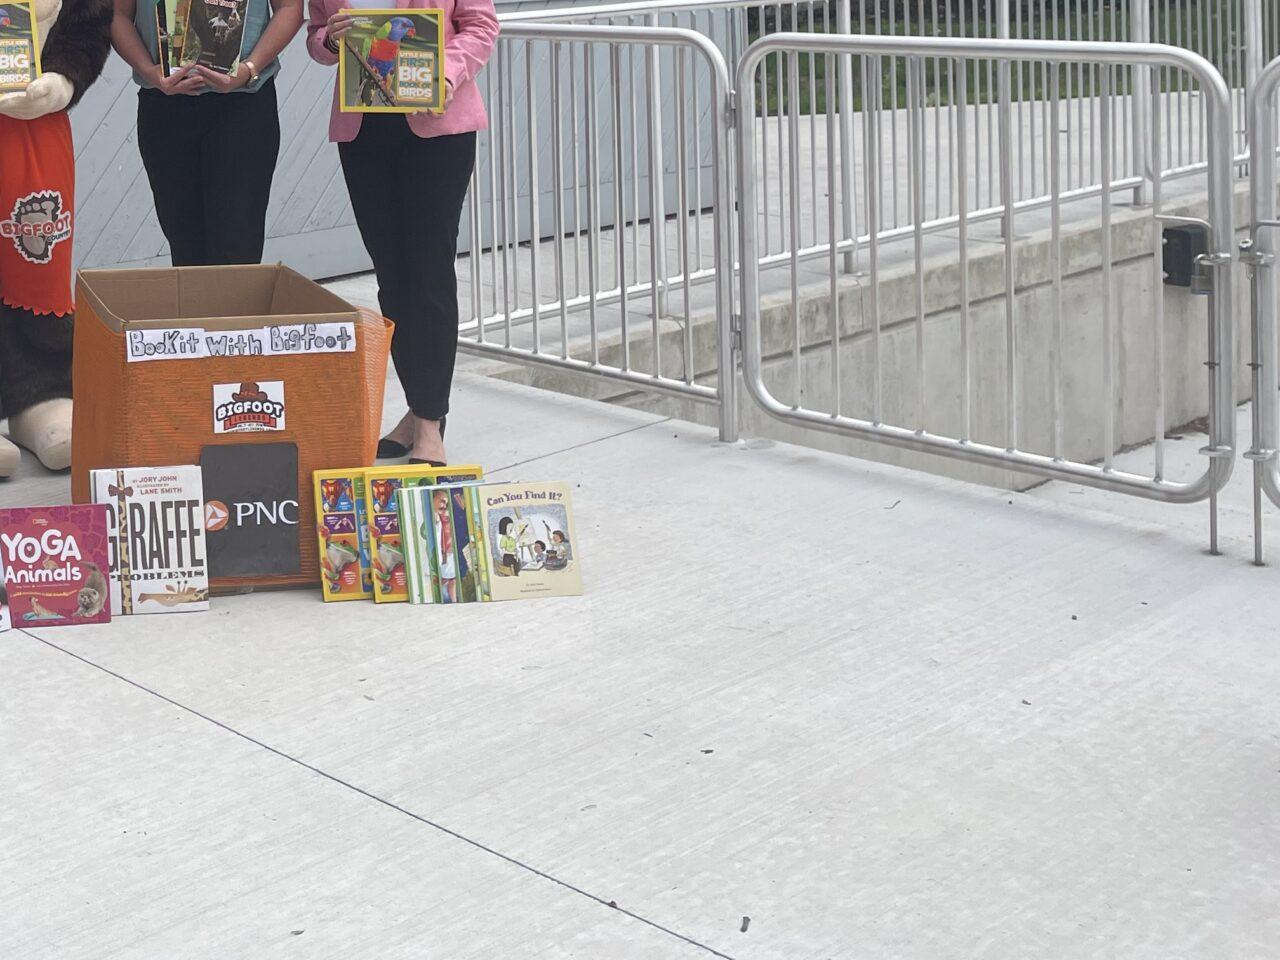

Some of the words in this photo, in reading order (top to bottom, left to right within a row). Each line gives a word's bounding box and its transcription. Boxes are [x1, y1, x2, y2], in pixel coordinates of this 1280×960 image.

[0, 74, 30, 83] BIRDS
[399, 66, 432, 81] BIG
[399, 87, 432, 97] BIRDS
[1, 215, 69, 237] BIGFOOT
[270, 323, 352, 352] Bigfoot
[217, 401, 283, 419] BIGFOOT
[487, 497, 504, 506] Can
[503, 493, 522, 501] You
[524, 491, 546, 499] Find
[234, 500, 299, 527] PNC
[4, 562, 82, 584] Animals
